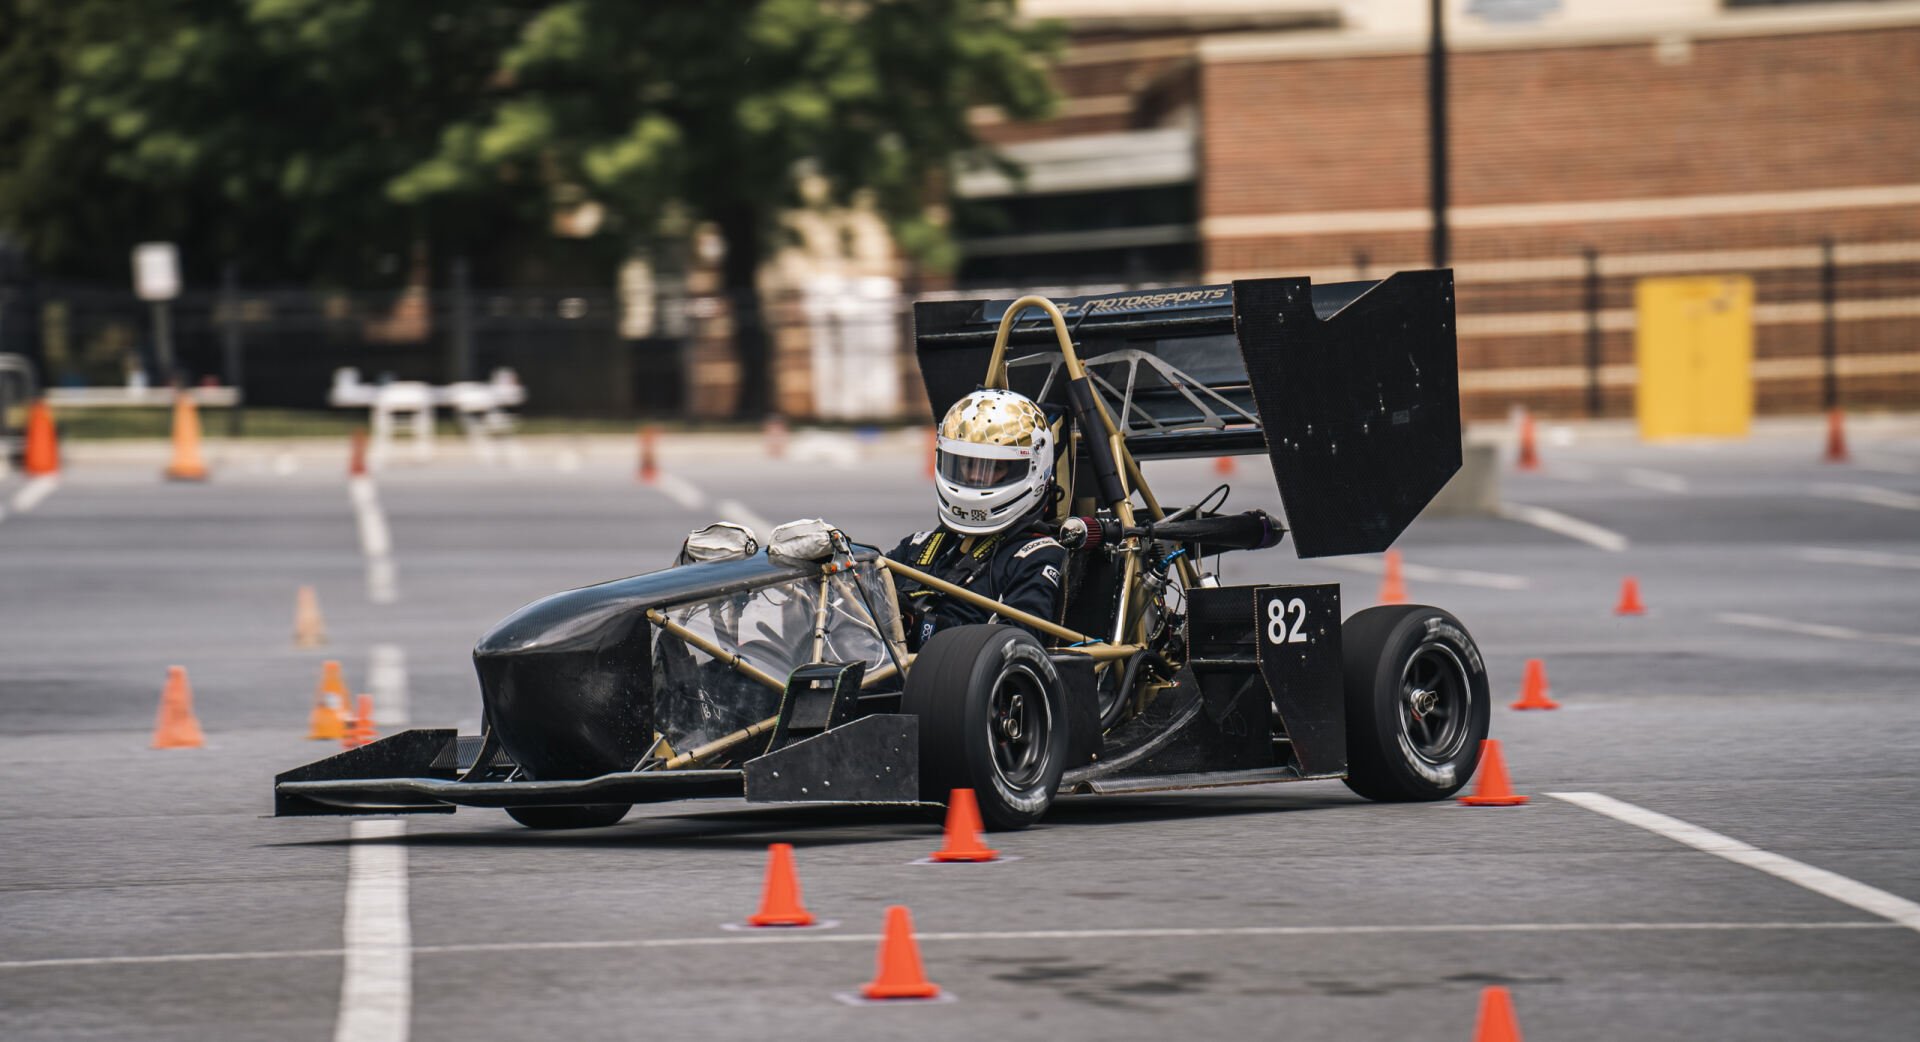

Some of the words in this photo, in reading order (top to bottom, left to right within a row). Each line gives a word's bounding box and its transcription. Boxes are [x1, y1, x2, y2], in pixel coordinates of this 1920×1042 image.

[1081, 288, 1228, 310] MOTORSPORTS
[951, 505, 969, 520] GT
[1267, 597, 1307, 645] 82
